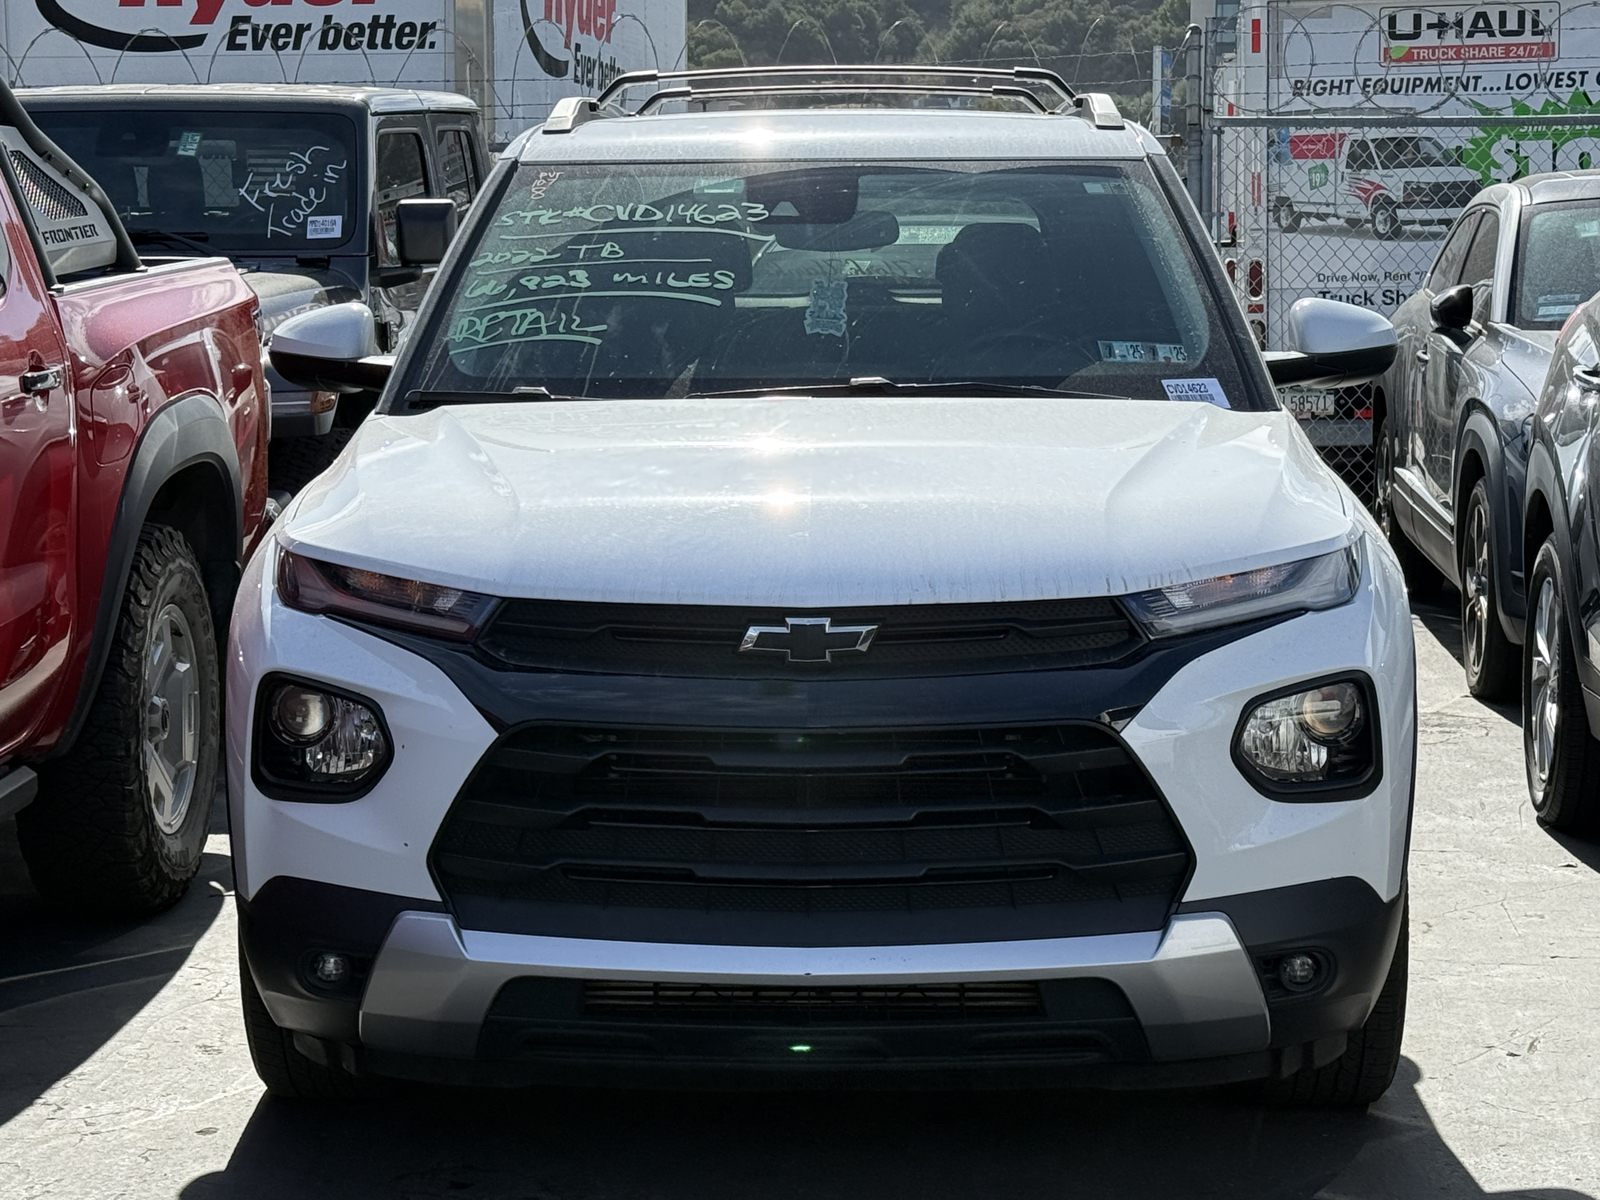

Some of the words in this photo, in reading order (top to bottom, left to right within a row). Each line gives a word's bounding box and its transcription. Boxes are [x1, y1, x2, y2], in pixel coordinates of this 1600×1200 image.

[226, 15, 312, 51] Ever
[318, 14, 437, 50] better.
[1388, 9, 1553, 40] U-HAUL
[574, 43, 598, 89] Ever
[1412, 49, 1456, 60] TRUCK
[1460, 47, 1505, 58] SHARE
[1509, 46, 1537, 56] 24/7
[1292, 79, 1354, 97] RIGHT
[1505, 71, 1589, 91] LOWEST
[239, 146, 329, 212] Fresh
[267, 187, 326, 238] Trade
[41, 223, 99, 246] FRONTIER
[1317, 272, 1348, 283] Drive
[1351, 271, 1381, 283] Now,
[1384, 270, 1412, 282] Rent
[455, 308, 608, 343] RETAIL
[1166, 382, 1209, 395] CVD14623
